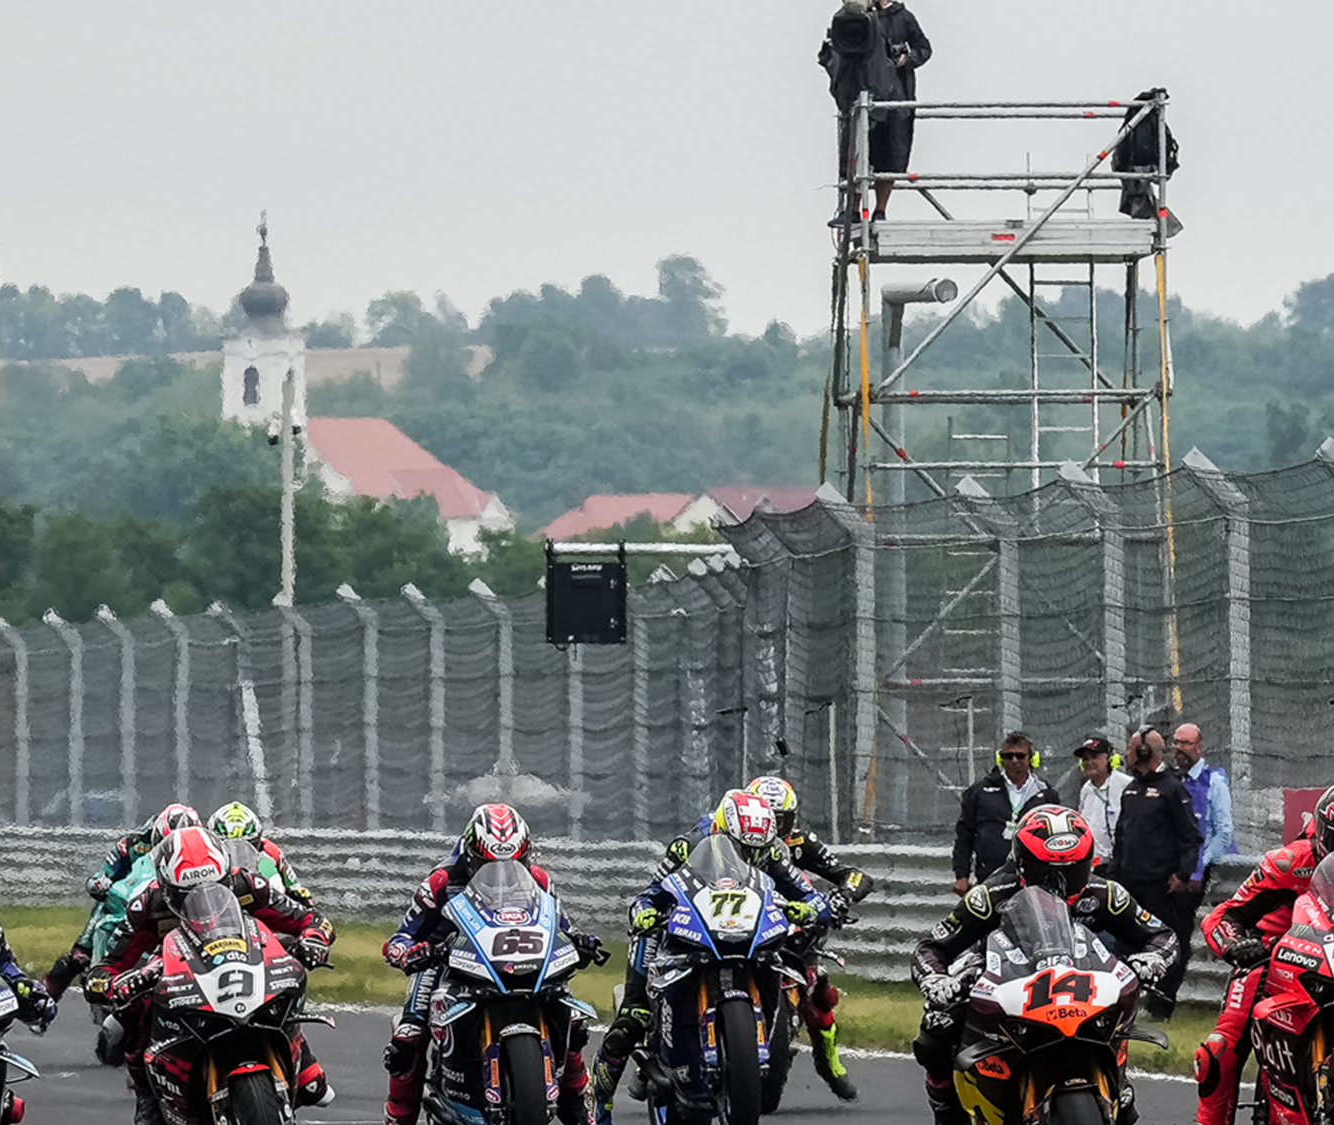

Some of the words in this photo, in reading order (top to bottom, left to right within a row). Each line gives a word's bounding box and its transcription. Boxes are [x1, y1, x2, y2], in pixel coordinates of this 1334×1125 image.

[182, 868, 216, 882] AIROH
[711, 893, 747, 917] 77
[501, 912, 522, 920] PATA
[673, 926, 702, 941] YAMAHA
[209, 940, 242, 952] BARDAHL
[492, 929, 544, 957] 65
[1282, 938, 1322, 954] ALTEN
[226, 952, 247, 961] dto
[451, 949, 476, 960] YAMAHA
[1278, 949, 1317, 968] Lenovo
[270, 966, 294, 975] NEXT
[1036, 956, 1060, 971] elf
[167, 983, 194, 993] NEXT
[216, 969, 254, 1003] 9
[976, 982, 996, 993] MAX
[1023, 969, 1097, 1014] 14
[1058, 1007, 1088, 1019] Beta
